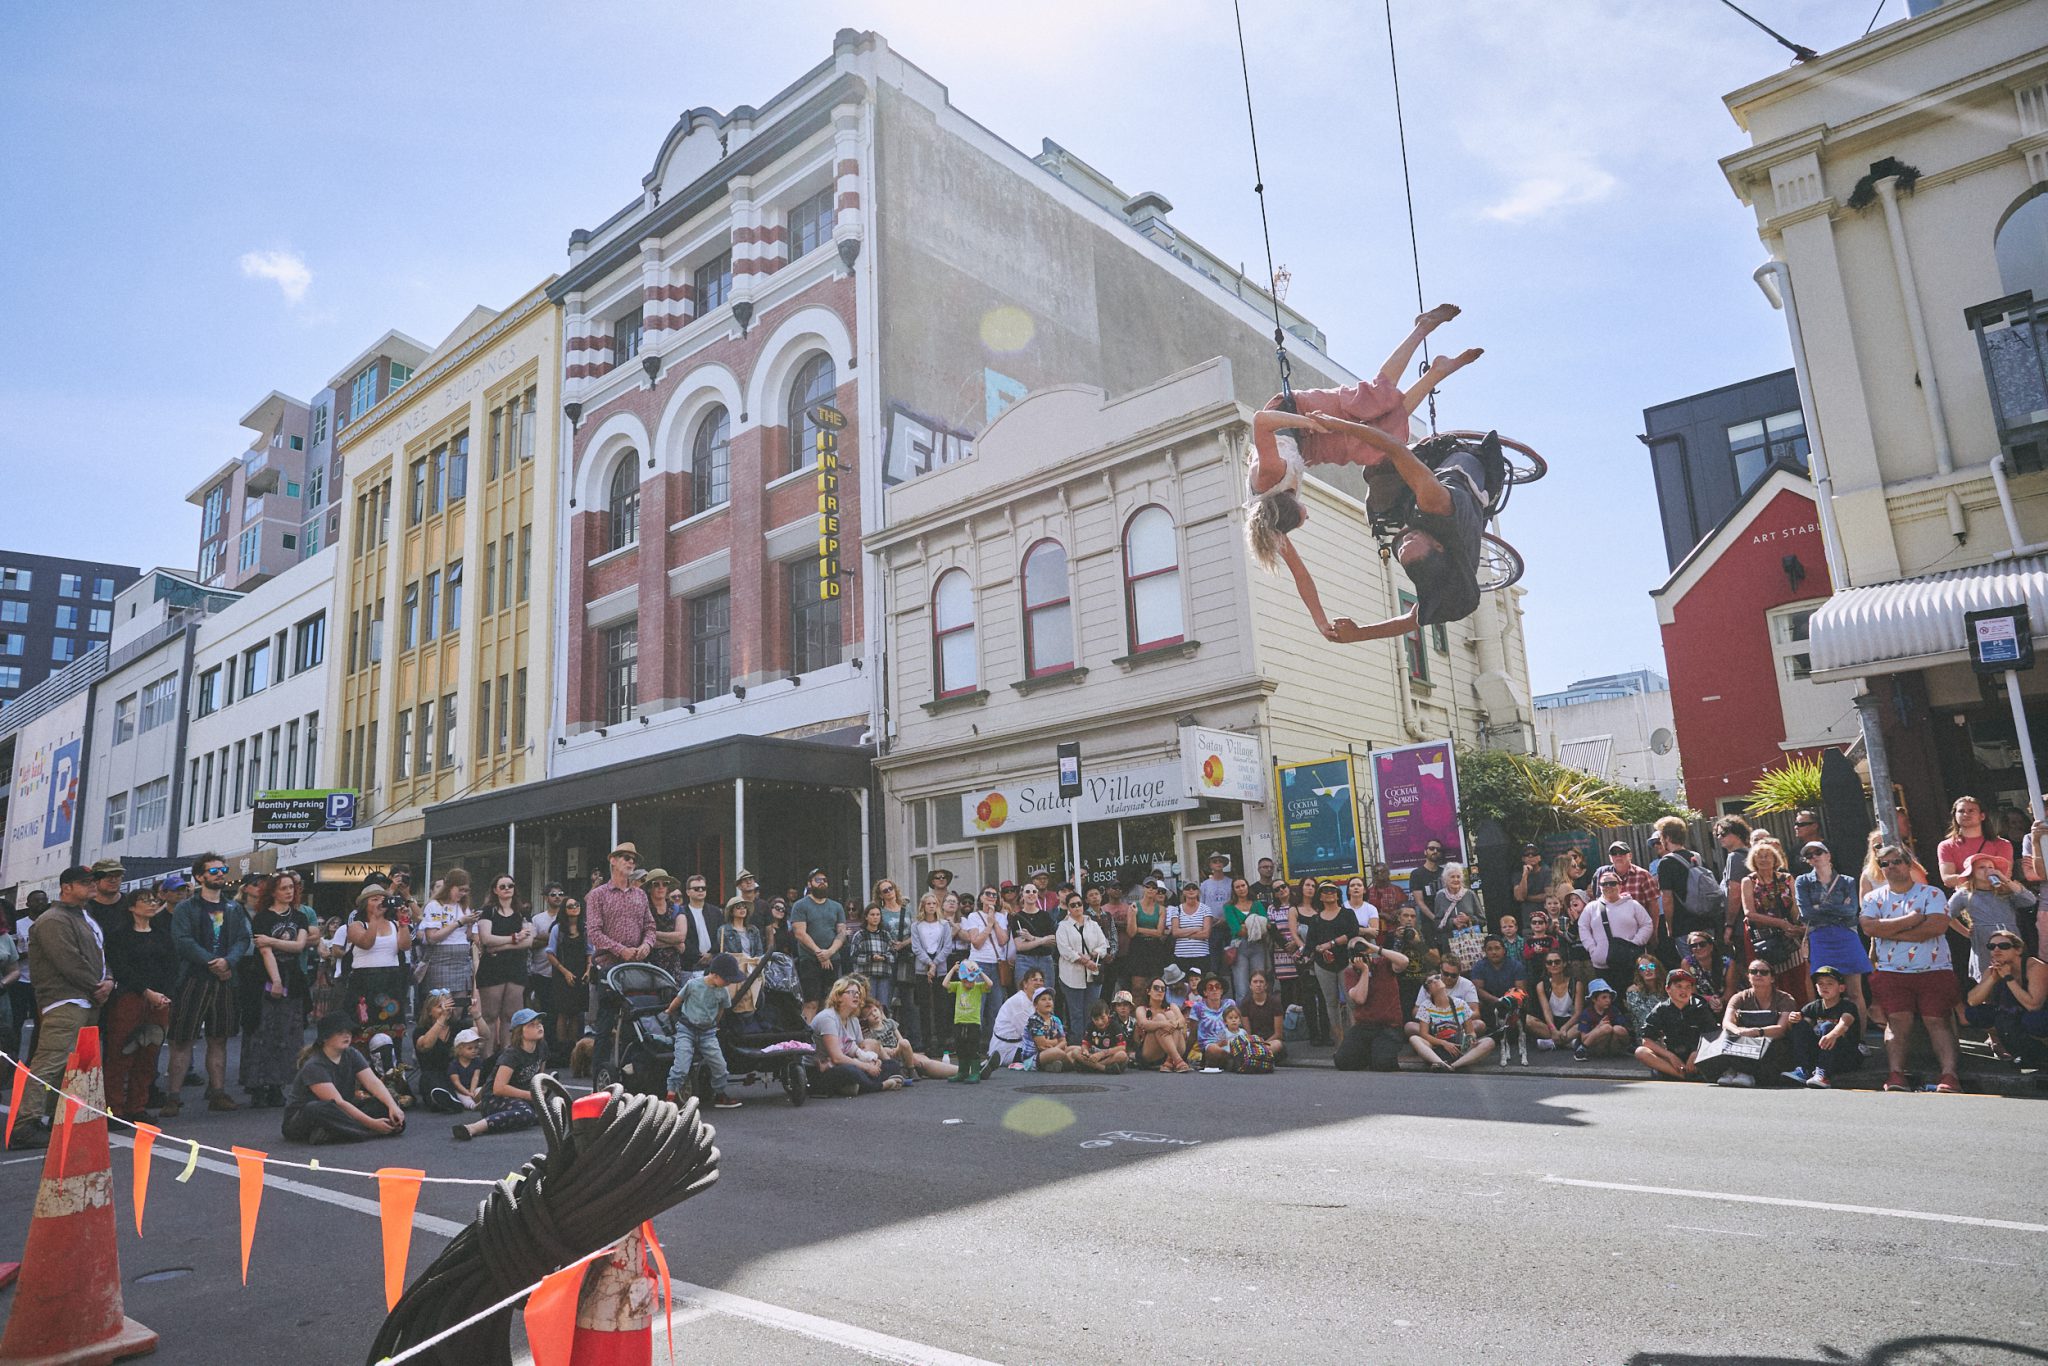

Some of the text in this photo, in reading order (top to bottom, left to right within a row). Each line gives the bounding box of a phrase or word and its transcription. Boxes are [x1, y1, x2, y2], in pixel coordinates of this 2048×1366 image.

[446, 344, 517, 406] BUILDINGS
[817, 407, 842, 426] THE
[826, 434, 840, 596] INTREPID
[1753, 532, 1776, 544] ART
[1198, 734, 1254, 757] Satay Village
[1087, 776, 1165, 804] Village
[1384, 786, 1418, 799] COCKTAIL
[257, 800, 325, 810] Monthly Parking
[331, 795, 349, 816] P
[1104, 798, 1179, 815] Malaysian Cuisine
[1287, 799, 1319, 812] COCKTAIL
[1393, 795, 1419, 808] SPIRITS
[271, 811, 310, 820] Available
[1296, 808, 1320, 820] SPIRITS
[12, 820, 39, 842] PARKING
[1027, 862, 1056, 875] DINE
